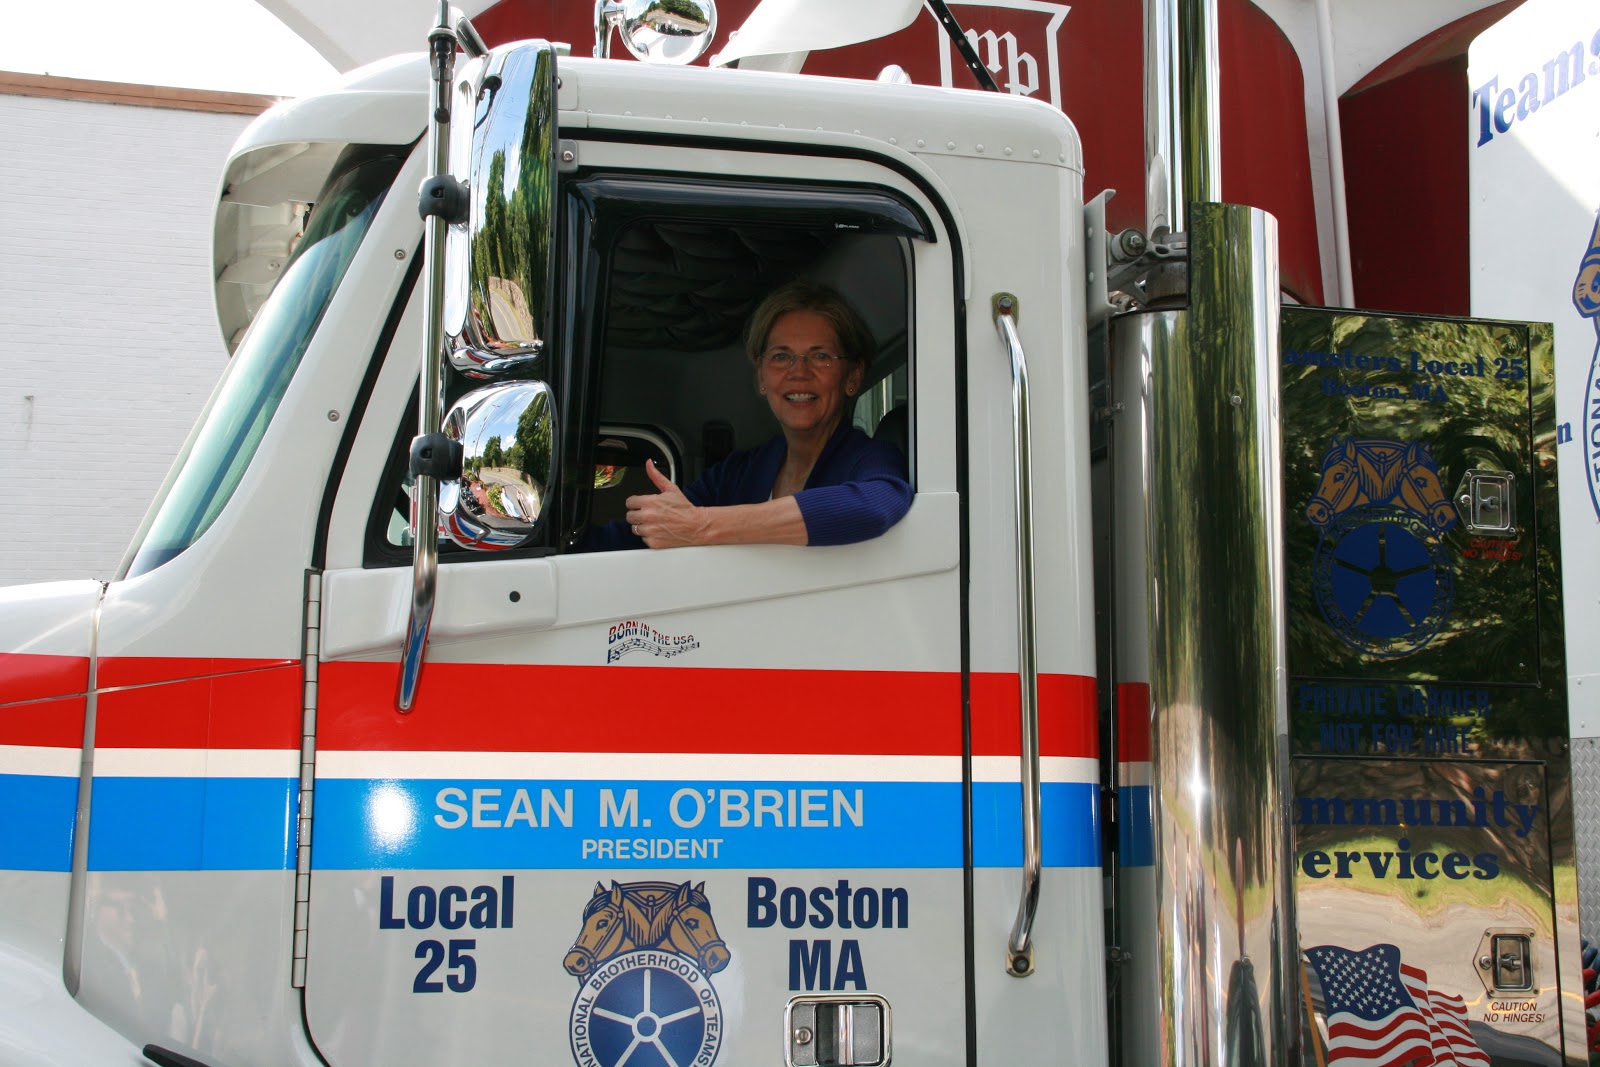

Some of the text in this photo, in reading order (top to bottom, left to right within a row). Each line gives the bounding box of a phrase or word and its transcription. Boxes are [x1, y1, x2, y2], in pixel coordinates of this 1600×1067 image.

[1410, 352, 1486, 378] Local
[1494, 357, 1526, 380] 25
[1321, 377, 1450, 404] Boston, MA
[608, 621, 694, 646] BORN IN THE USA
[1299, 685, 1490, 717] PRIVATE CARRIER
[1319, 722, 1473, 754] NOT FOR HIRE
[433, 787, 864, 828] SEAN M. O'BRIEN
[582, 838, 724, 860] PRESIDENT
[1296, 838, 1500, 880] ervices
[379, 875, 514, 929] Local
[747, 877, 909, 929] Boston
[413, 939, 477, 993] 25
[590, 954, 699, 991] BROTHERHOOD
[789, 939, 868, 991] MA
[699, 988, 716, 1008] OF
[1491, 1001, 1537, 1011] CAUTION
[1483, 1013, 1545, 1023] NO HINGES!
[694, 1013, 718, 1067] TEAMS
